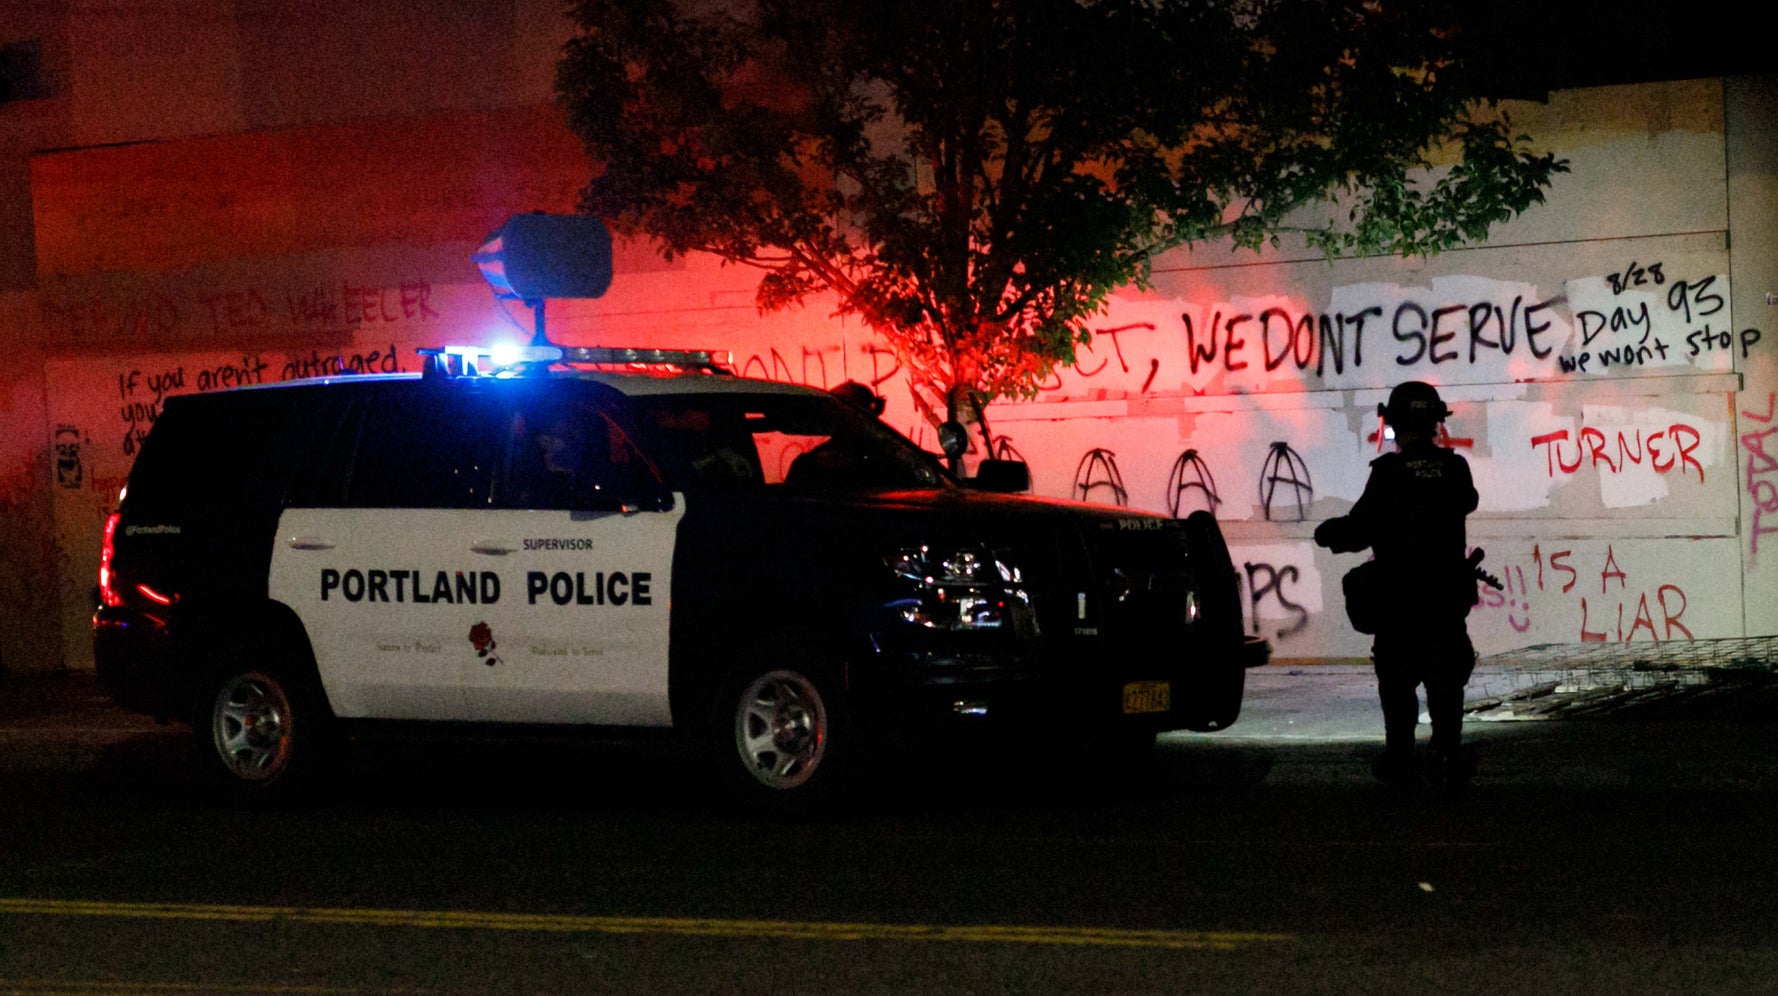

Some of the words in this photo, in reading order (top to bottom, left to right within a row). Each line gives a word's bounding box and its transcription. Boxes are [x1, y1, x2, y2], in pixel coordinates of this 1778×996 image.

[1607, 262, 1666, 296] 8/28
[1181, 312, 1252, 374] WE
[1259, 305, 1383, 377] DONT
[1392, 295, 1565, 365] SERVE
[1576, 301, 1651, 346] Day
[1667, 275, 1724, 324] 93
[1559, 352, 1590, 374] we
[1686, 324, 1761, 359] stop
[119, 370, 141, 399] If
[146, 367, 184, 404] you
[196, 356, 269, 391] aren't
[1531, 423, 1705, 485] TURNER
[522, 537, 594, 551] SUPERVISOR
[1601, 543, 1627, 595] A
[321, 568, 501, 605] PORTLAND
[527, 570, 653, 607] POLICE
[1235, 561, 1308, 639] PS
[1580, 583, 1695, 645] LIAR
